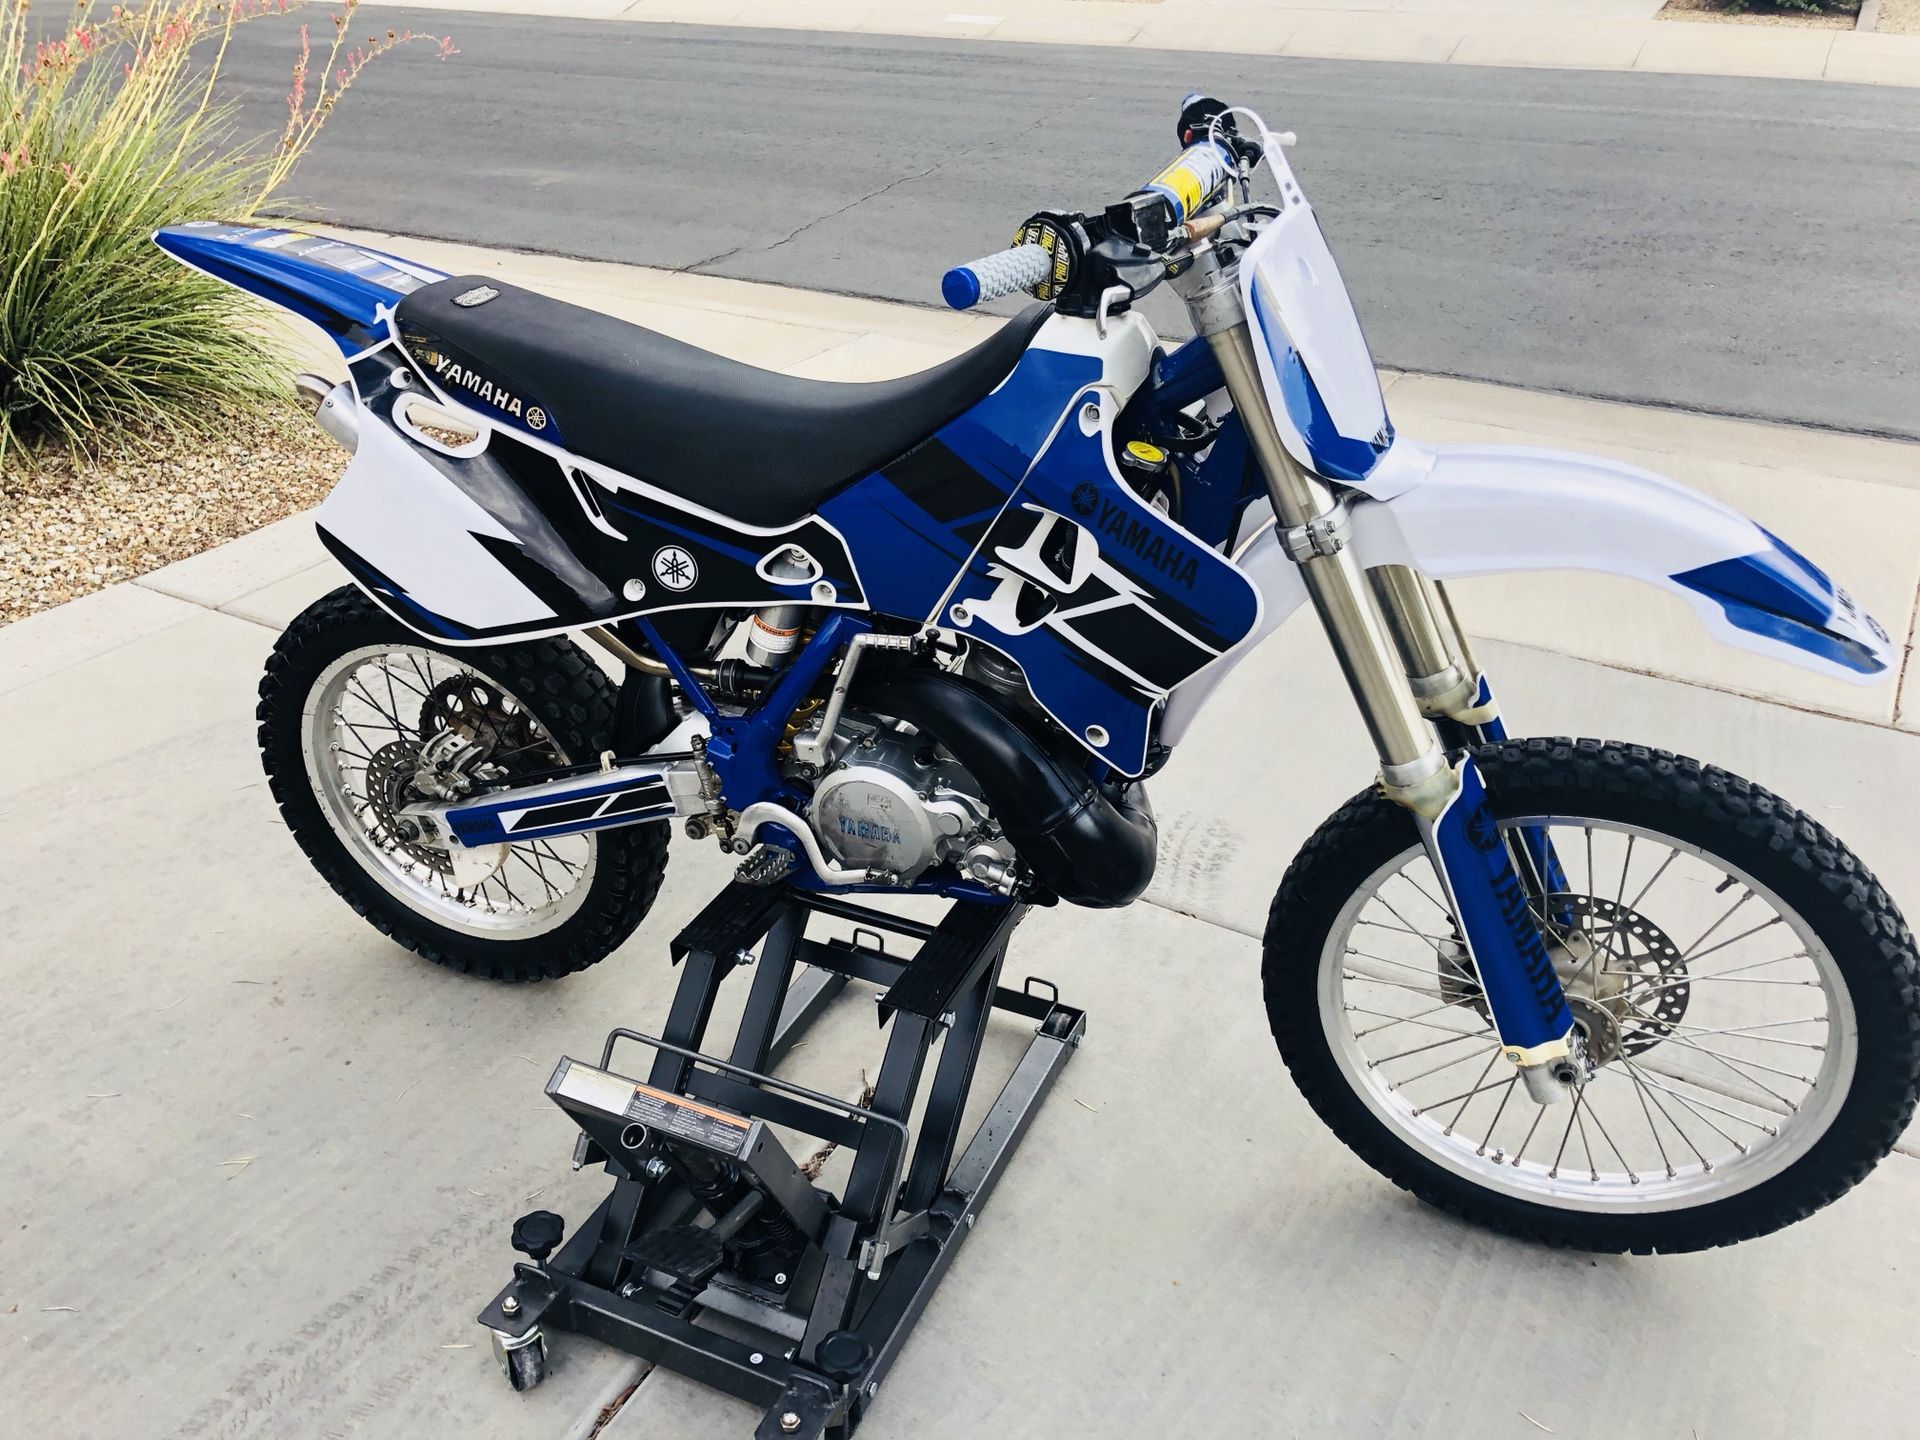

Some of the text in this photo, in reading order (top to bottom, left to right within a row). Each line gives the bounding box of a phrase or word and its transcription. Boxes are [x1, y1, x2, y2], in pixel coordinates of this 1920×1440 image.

[435, 353, 522, 418] YAMAHA
[1097, 498, 1199, 591] YAMAHA
[839, 815, 901, 844] YAMAHA
[1490, 861, 1567, 1024] YAMAHA
